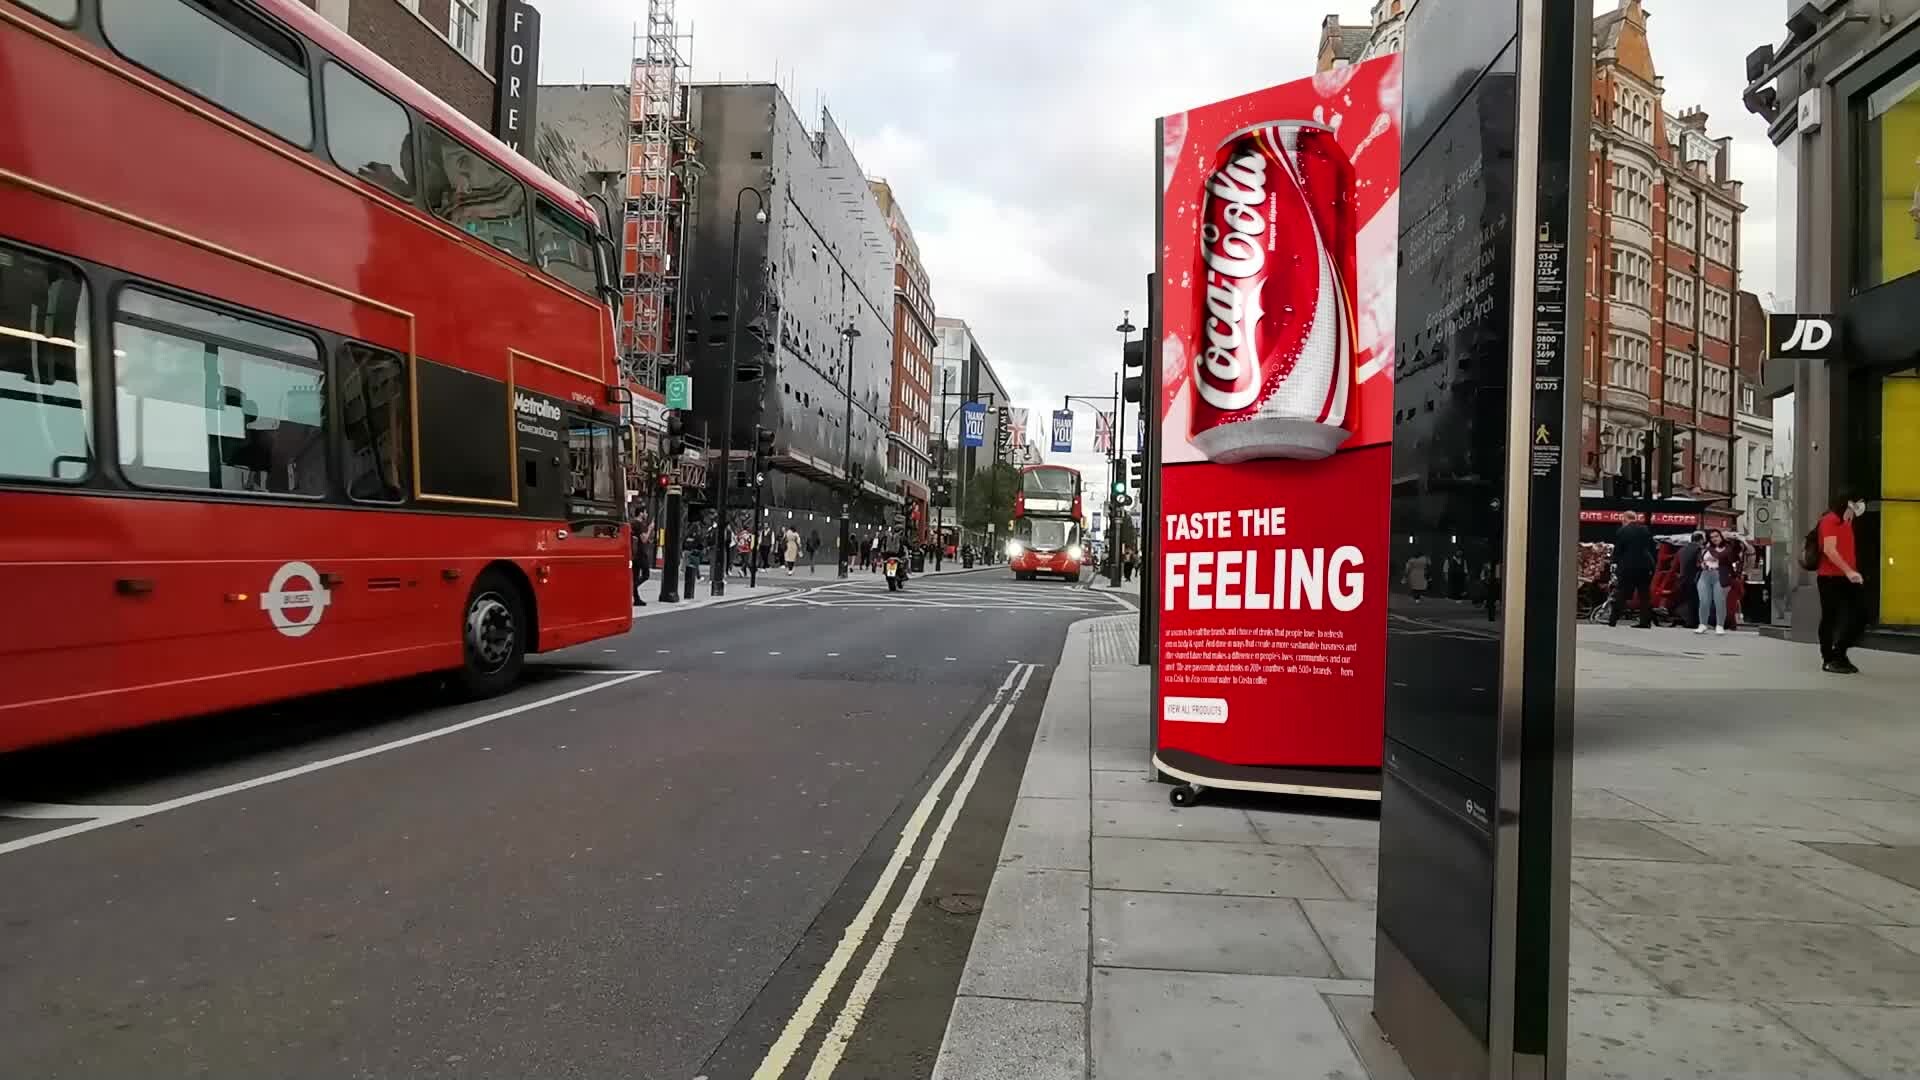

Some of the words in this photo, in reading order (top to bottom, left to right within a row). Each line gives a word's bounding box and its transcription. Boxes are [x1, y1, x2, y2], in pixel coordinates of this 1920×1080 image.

[1193, 150, 1267, 410] Coca-Cola
[1472, 293, 1495, 325] Arch
[1781, 320, 1832, 351] JD
[514, 392, 561, 421] Metroline
[965, 410, 985, 421] THANK
[966, 420, 984, 436] YOU
[1054, 428, 1072, 442] YOU
[1166, 510, 1232, 540] TASTE
[1238, 507, 1286, 537] THE
[1164, 545, 1365, 612] FEELING
